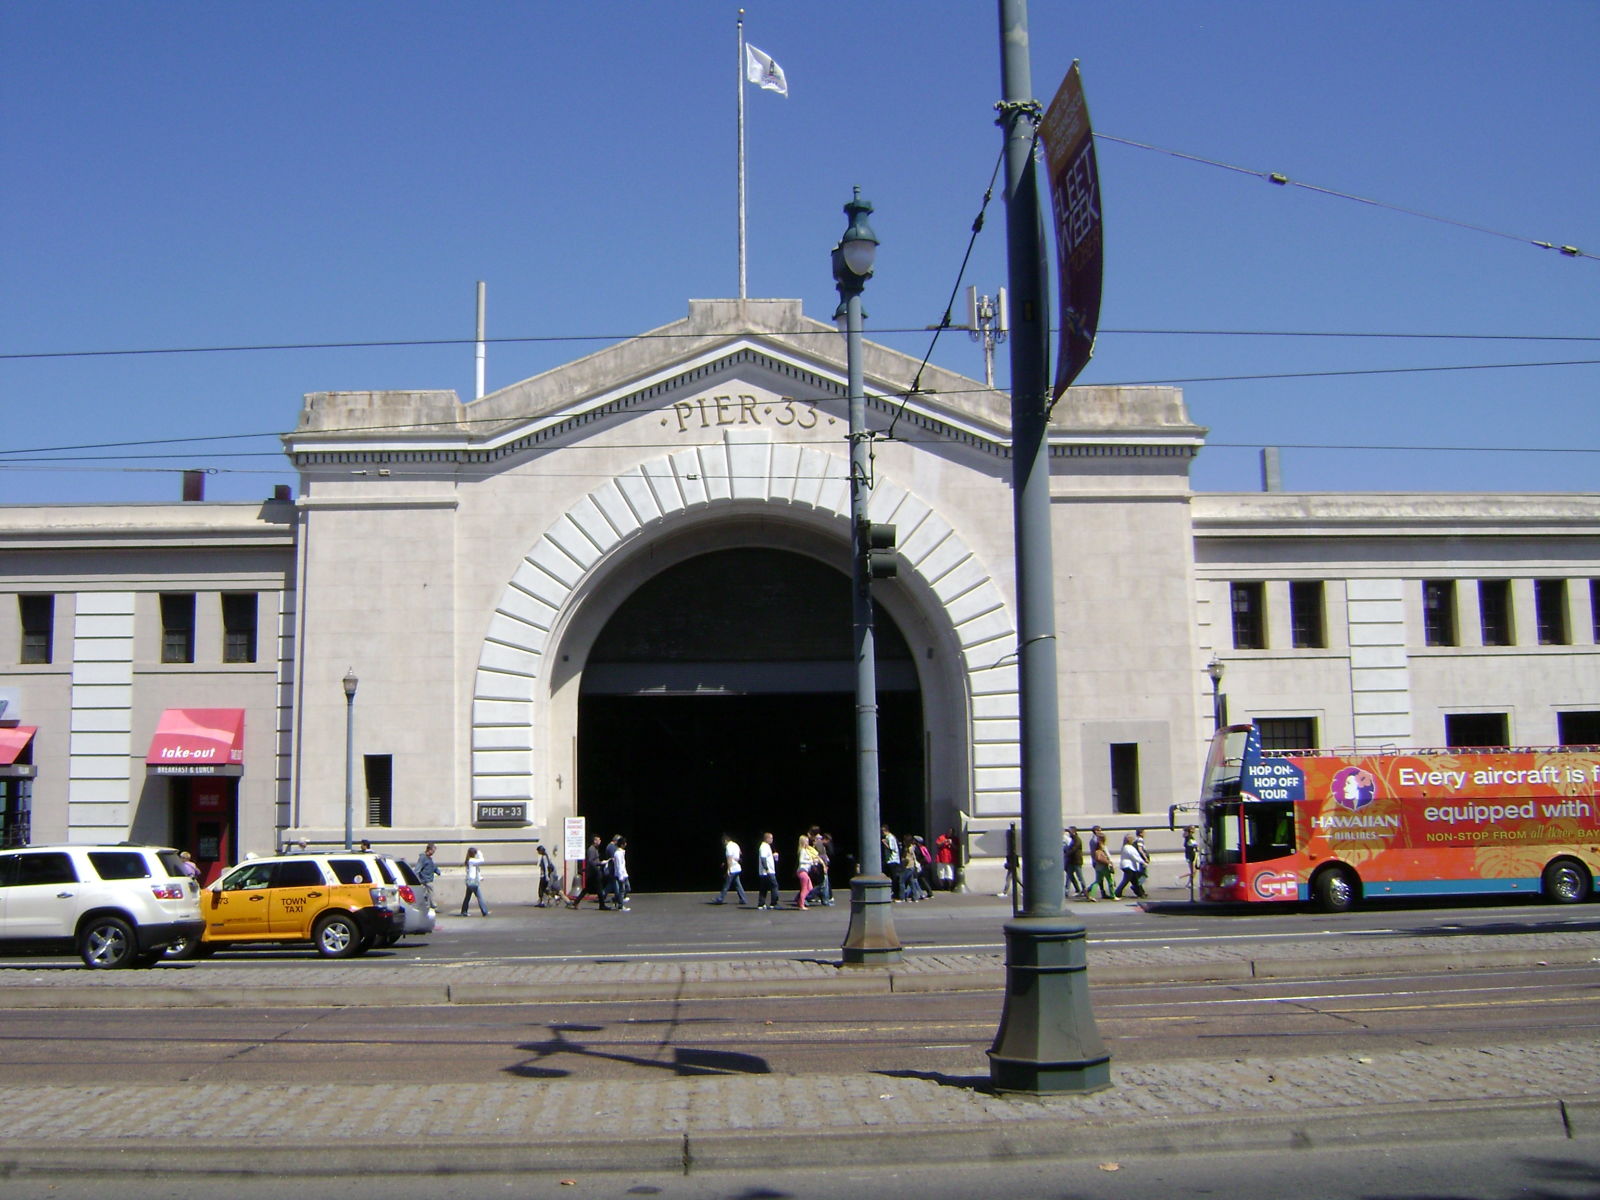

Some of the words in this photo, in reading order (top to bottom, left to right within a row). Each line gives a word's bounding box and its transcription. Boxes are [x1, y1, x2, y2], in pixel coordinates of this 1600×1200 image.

[1057, 183, 1099, 264] WEEK
[673, 394, 762, 432] PIER
[775, 396, 819, 429] 33
[161, 746, 216, 758] take-out
[157, 766, 188, 774] BREAKFAST
[195, 766, 215, 774] LUNCH
[1249, 765, 1272, 776] HOP
[1273, 765, 1294, 776] ON-
[1254, 777, 1277, 788] HOP
[1279, 777, 1299, 787] OFF
[1399, 768, 1466, 789] Every
[1473, 766, 1560, 785] aircraft
[1566, 766, 1585, 783] is
[1260, 789, 1288, 799] TOUR
[1424, 800, 1535, 824] equipped
[1542, 800, 1590, 818] with
[1311, 815, 1398, 828] HAWAIIAN
[1334, 831, 1377, 840] AIRLINES
[1426, 832, 1489, 841] NON-STOP
[1493, 831, 1527, 840] FROM
[1531, 824, 1545, 839] all
[281, 897, 307, 906] TOWN
[285, 905, 304, 913] TAXI
